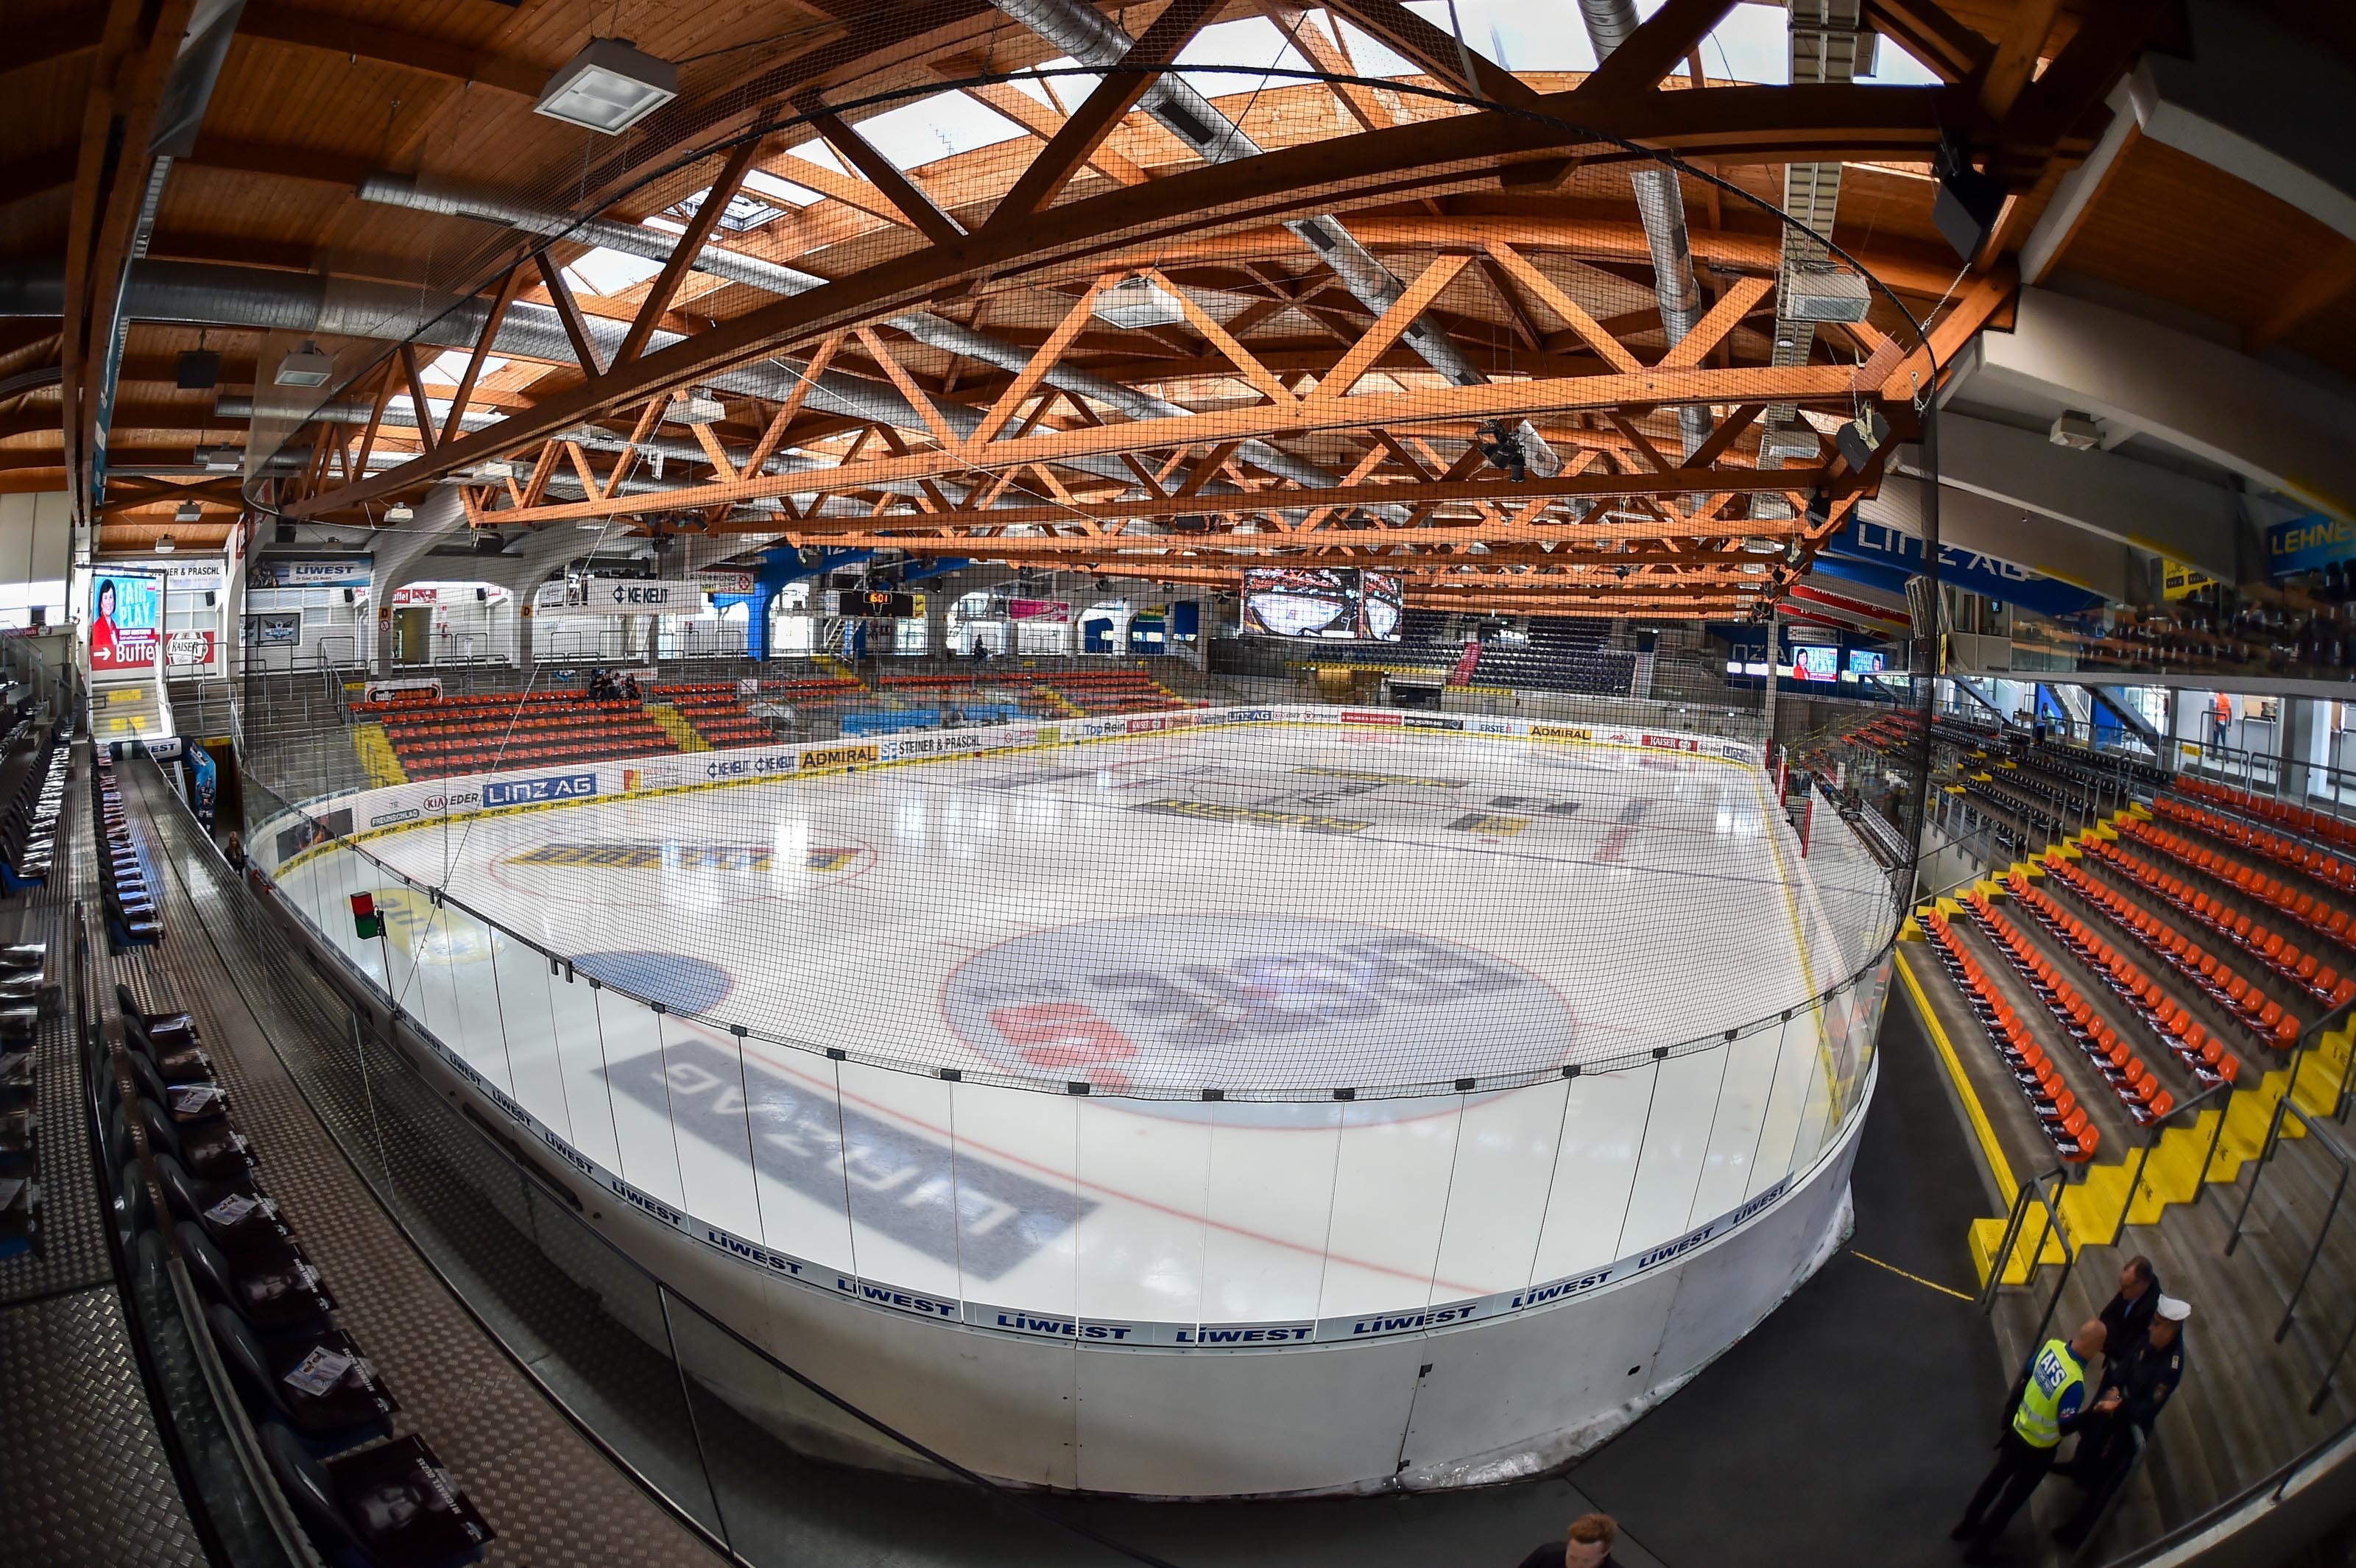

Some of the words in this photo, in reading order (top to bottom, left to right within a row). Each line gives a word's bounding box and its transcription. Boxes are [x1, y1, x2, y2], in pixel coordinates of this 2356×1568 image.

[188, 567, 220, 576] PRASCHL
[119, 581, 147, 605] FAIR
[628, 587, 641, 602] KE
[643, 587, 668, 603] KELIT
[870, 593, 888, 603] 16:01
[119, 602, 150, 628] PLAY
[381, 608, 387, 618] D
[523, 607, 530, 616] D
[172, 640, 198, 653] KAISER
[1252, 711, 1270, 720] AG
[1084, 724, 1102, 735] Top
[1104, 722, 1126, 733] Rein
[1480, 724, 1505, 733] ERSTE
[1531, 726, 1591, 741] ADMIRAL
[899, 739, 934, 755] STEINER
[937, 739, 943, 750] &
[945, 735, 981, 749] PRASCHL
[1650, 736, 1676, 748] KAISER
[765, 758, 775, 771] KE
[777, 756, 795, 769] KELIT
[803, 746, 877, 769] ADMIRAL
[718, 763, 729, 776] KE
[730, 760, 750, 774] KELIT
[489, 781, 549, 803] LINZ
[554, 777, 591, 796] AG
[428, 797, 444, 808] KIA
[450, 793, 479, 805] EDER
[432, 816, 453, 825] greiner
[461, 811, 482, 820] greiner
[380, 826, 399, 836] greiner
[407, 821, 426, 830] greiner
[2041, 1352, 2066, 1387] AFS
[416, 1458, 436, 1479] OUZAS
[433, 1480, 462, 1514] MICHAEL
